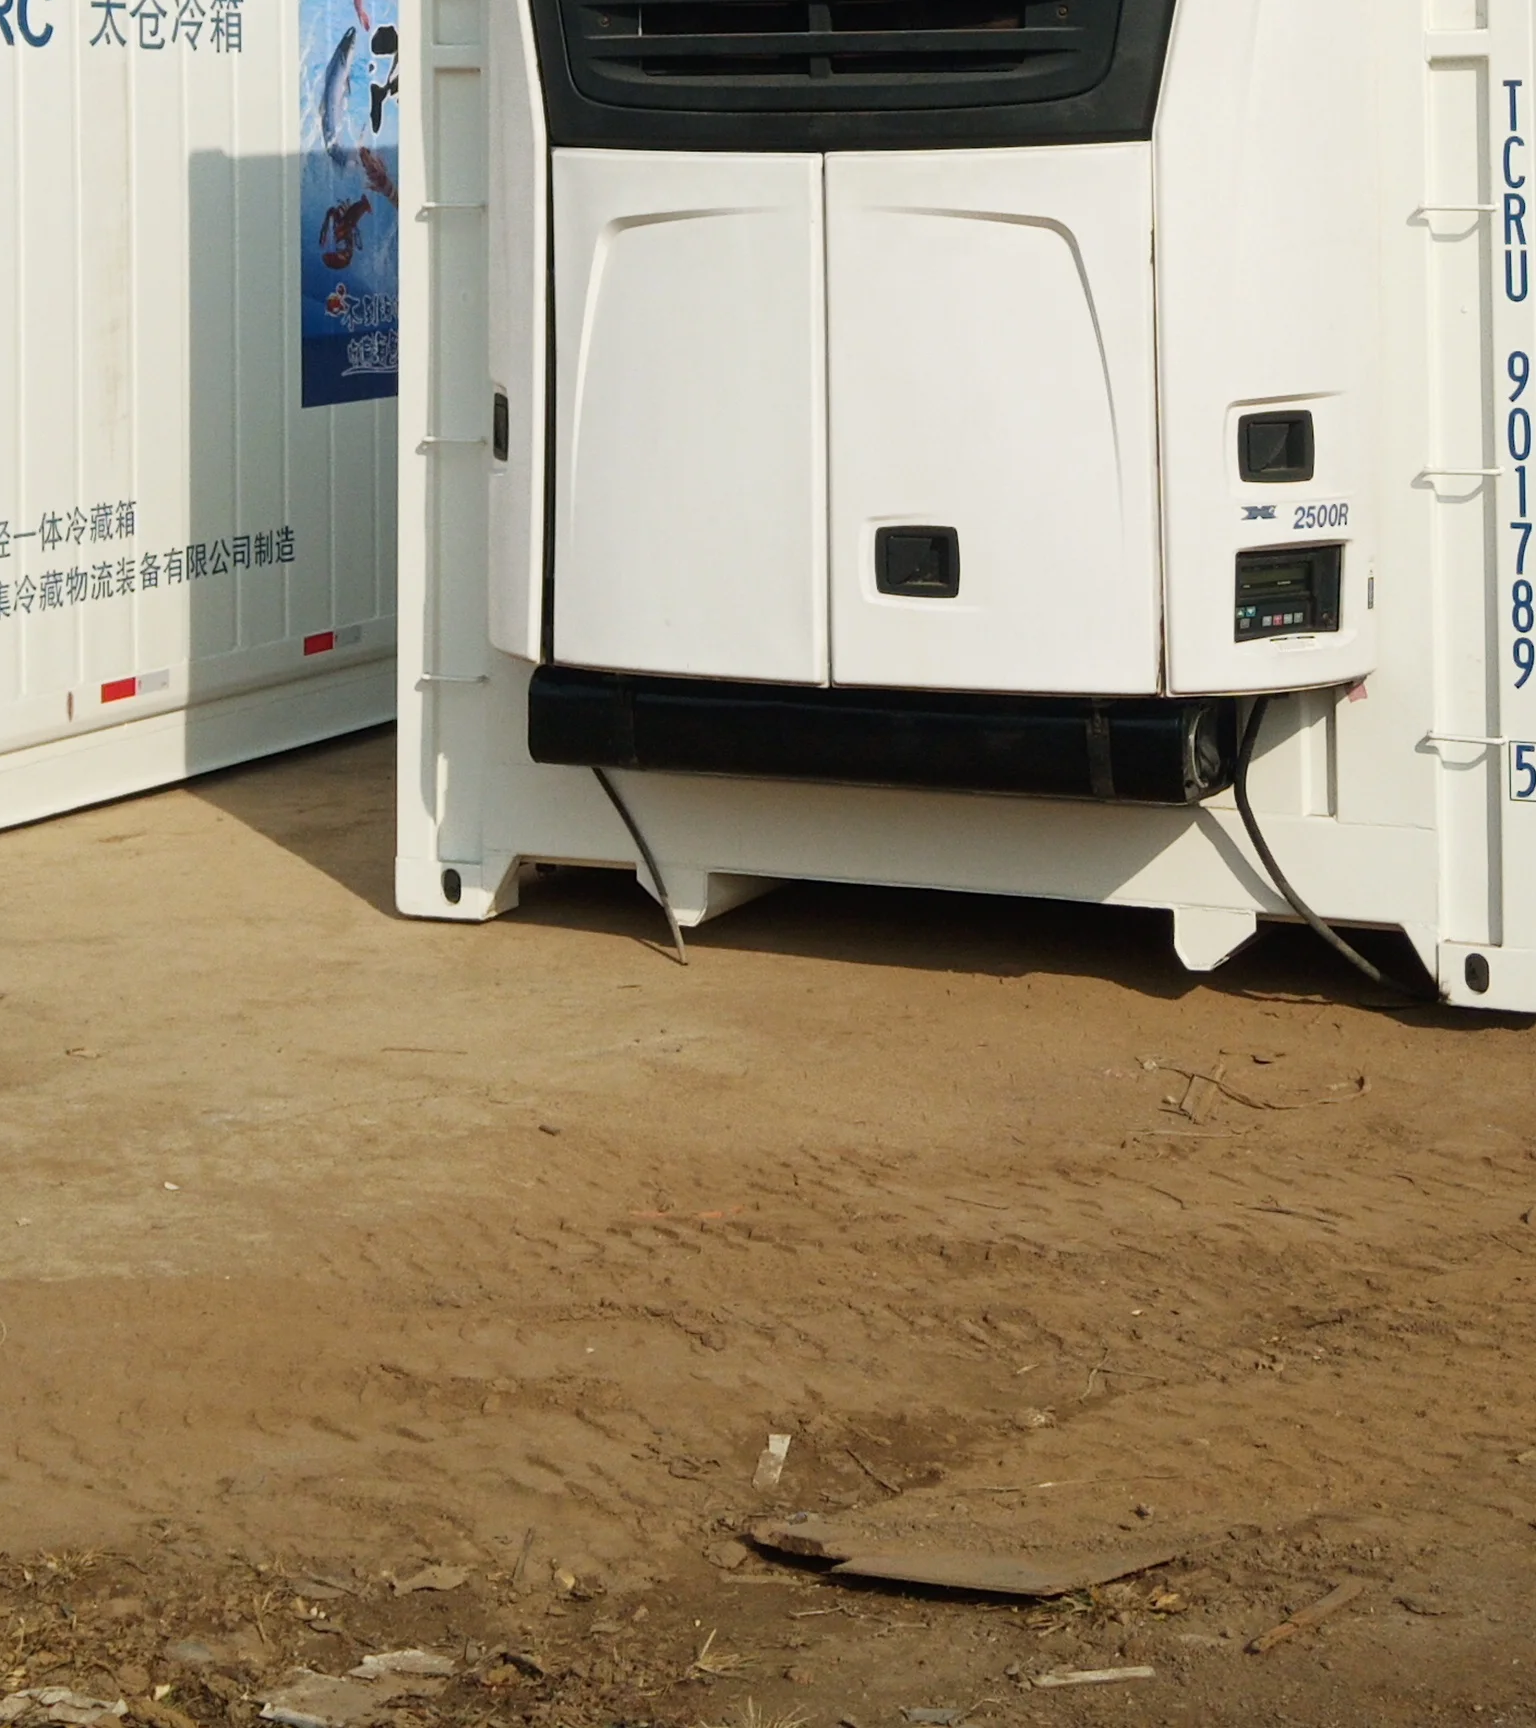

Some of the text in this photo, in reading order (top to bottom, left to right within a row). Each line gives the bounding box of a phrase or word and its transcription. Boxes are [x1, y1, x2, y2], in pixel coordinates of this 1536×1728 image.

[1502, 80, 1529, 302] TCRU
[1292, 503, 1349, 529] 2500R
[1506, 351, 1535, 688] 901789
